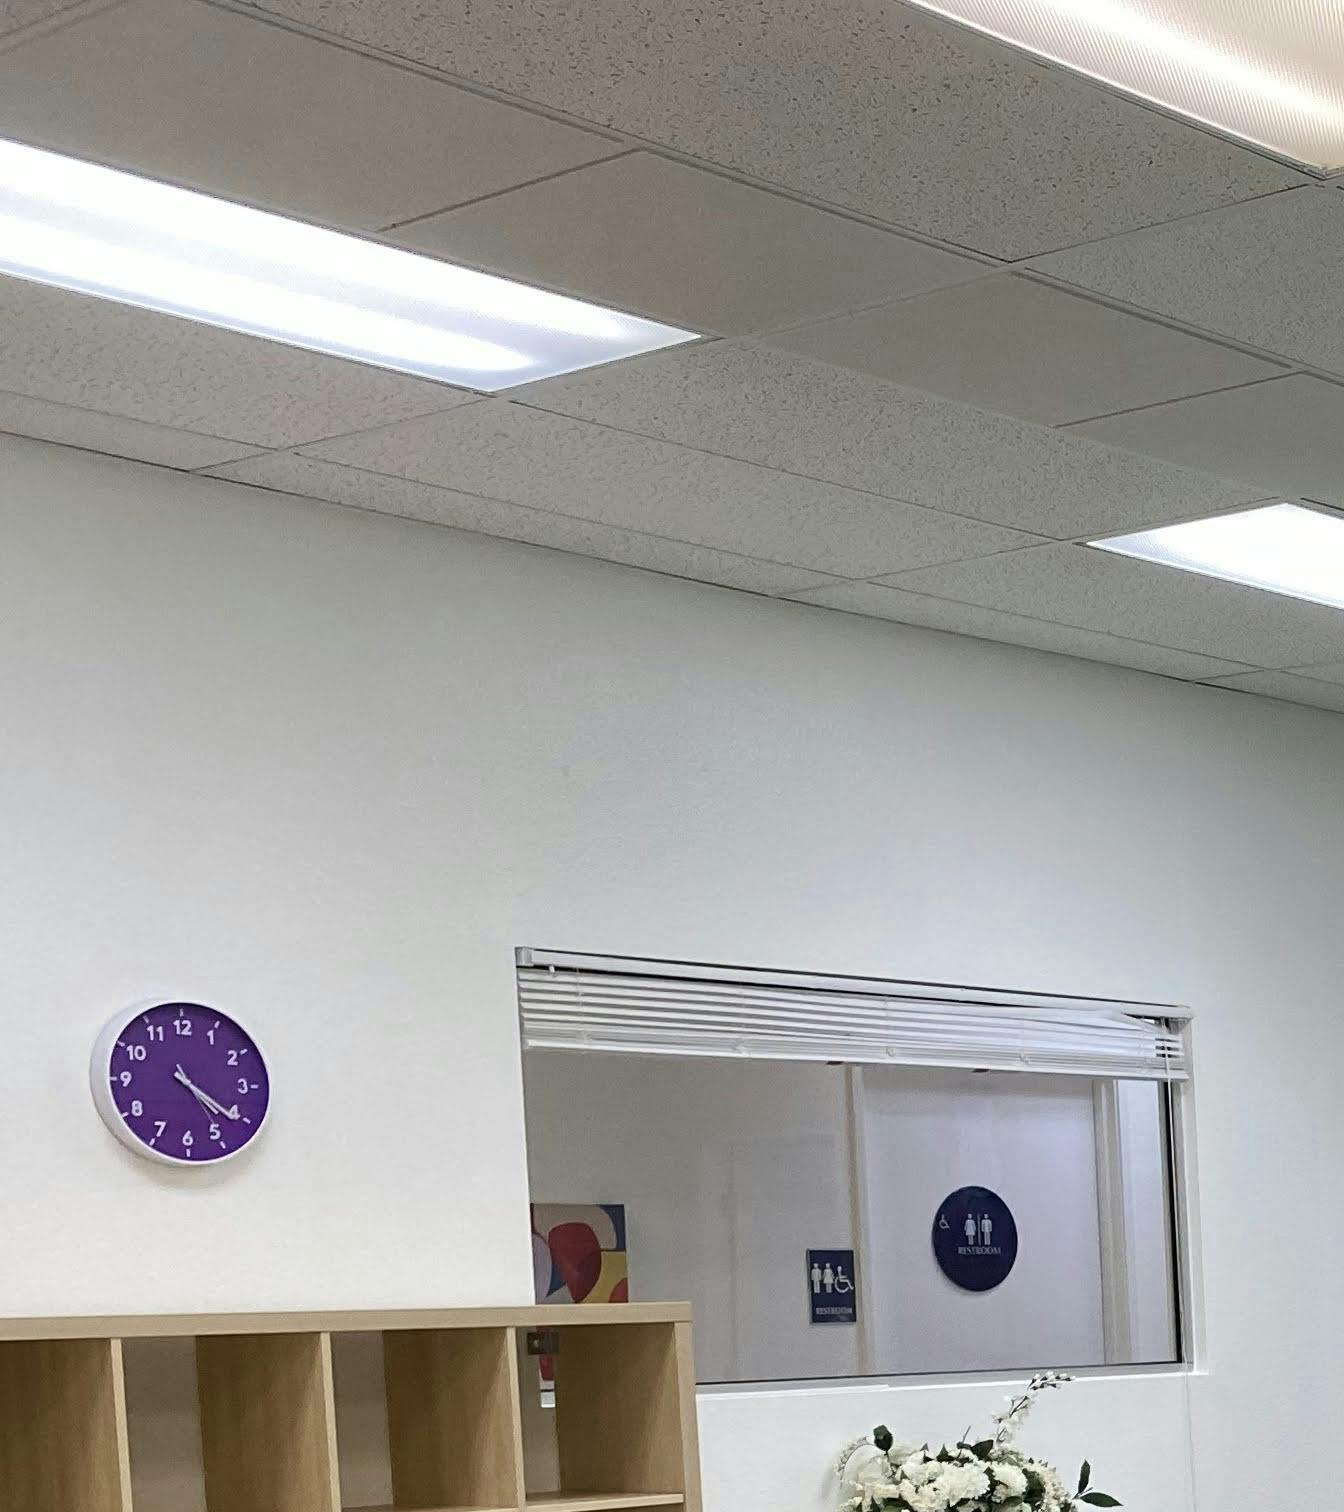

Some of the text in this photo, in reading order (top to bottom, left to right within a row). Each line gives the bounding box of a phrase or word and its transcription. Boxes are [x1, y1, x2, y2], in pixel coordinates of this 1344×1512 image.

[147, 1026, 164, 1041] 11
[173, 1020, 192, 1035] 12
[207, 1030, 215, 1045] 1
[127, 1046, 146, 1061] 10
[227, 1051, 238, 1065] 2
[120, 1072, 132, 1087] 9
[238, 1079, 248, 1093] 3
[132, 1101, 142, 1116] 8
[155, 1121, 166, 1136] 7
[209, 1124, 220, 1140] 5
[183, 1131, 193, 1145] 6
[958, 1246, 1000, 1255] RESTROOM
